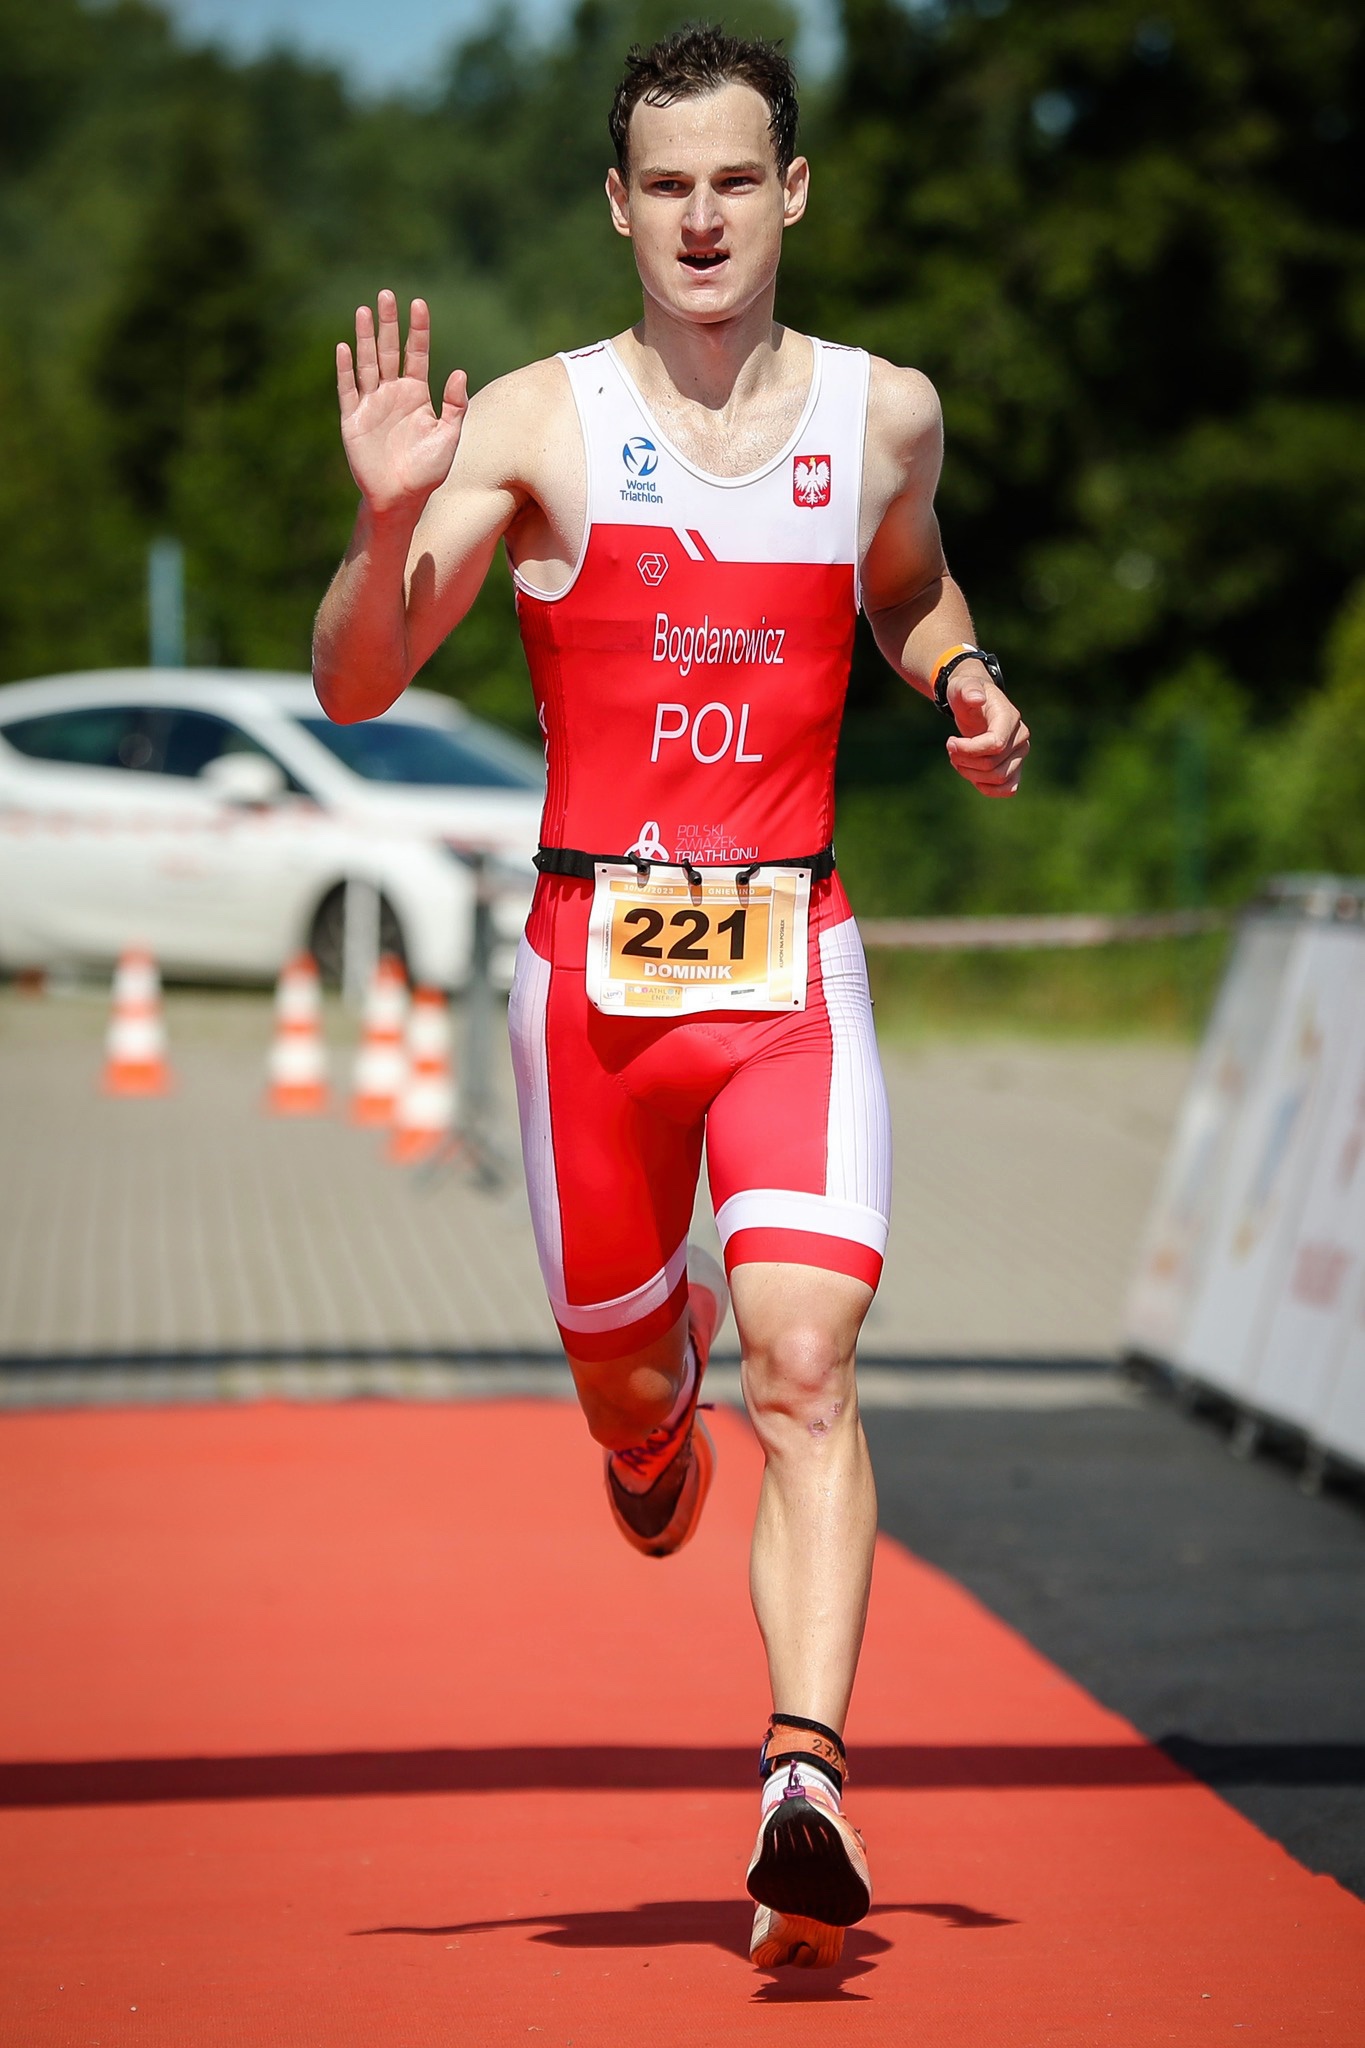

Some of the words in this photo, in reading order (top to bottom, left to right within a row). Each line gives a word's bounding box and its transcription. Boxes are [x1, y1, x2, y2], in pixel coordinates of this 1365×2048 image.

[626, 479, 656, 492] World
[619, 490, 663, 504] Triathlon
[652, 612, 786, 677] Bogdanowicz
[650, 701, 763, 764] POL
[677, 823, 724, 838] POLSKI
[674, 846, 759, 863] TRIATHLONU
[708, 887, 755, 895] GNIEWINO
[621, 908, 747, 961] 221
[643, 962, 733, 980] DOMINIK
